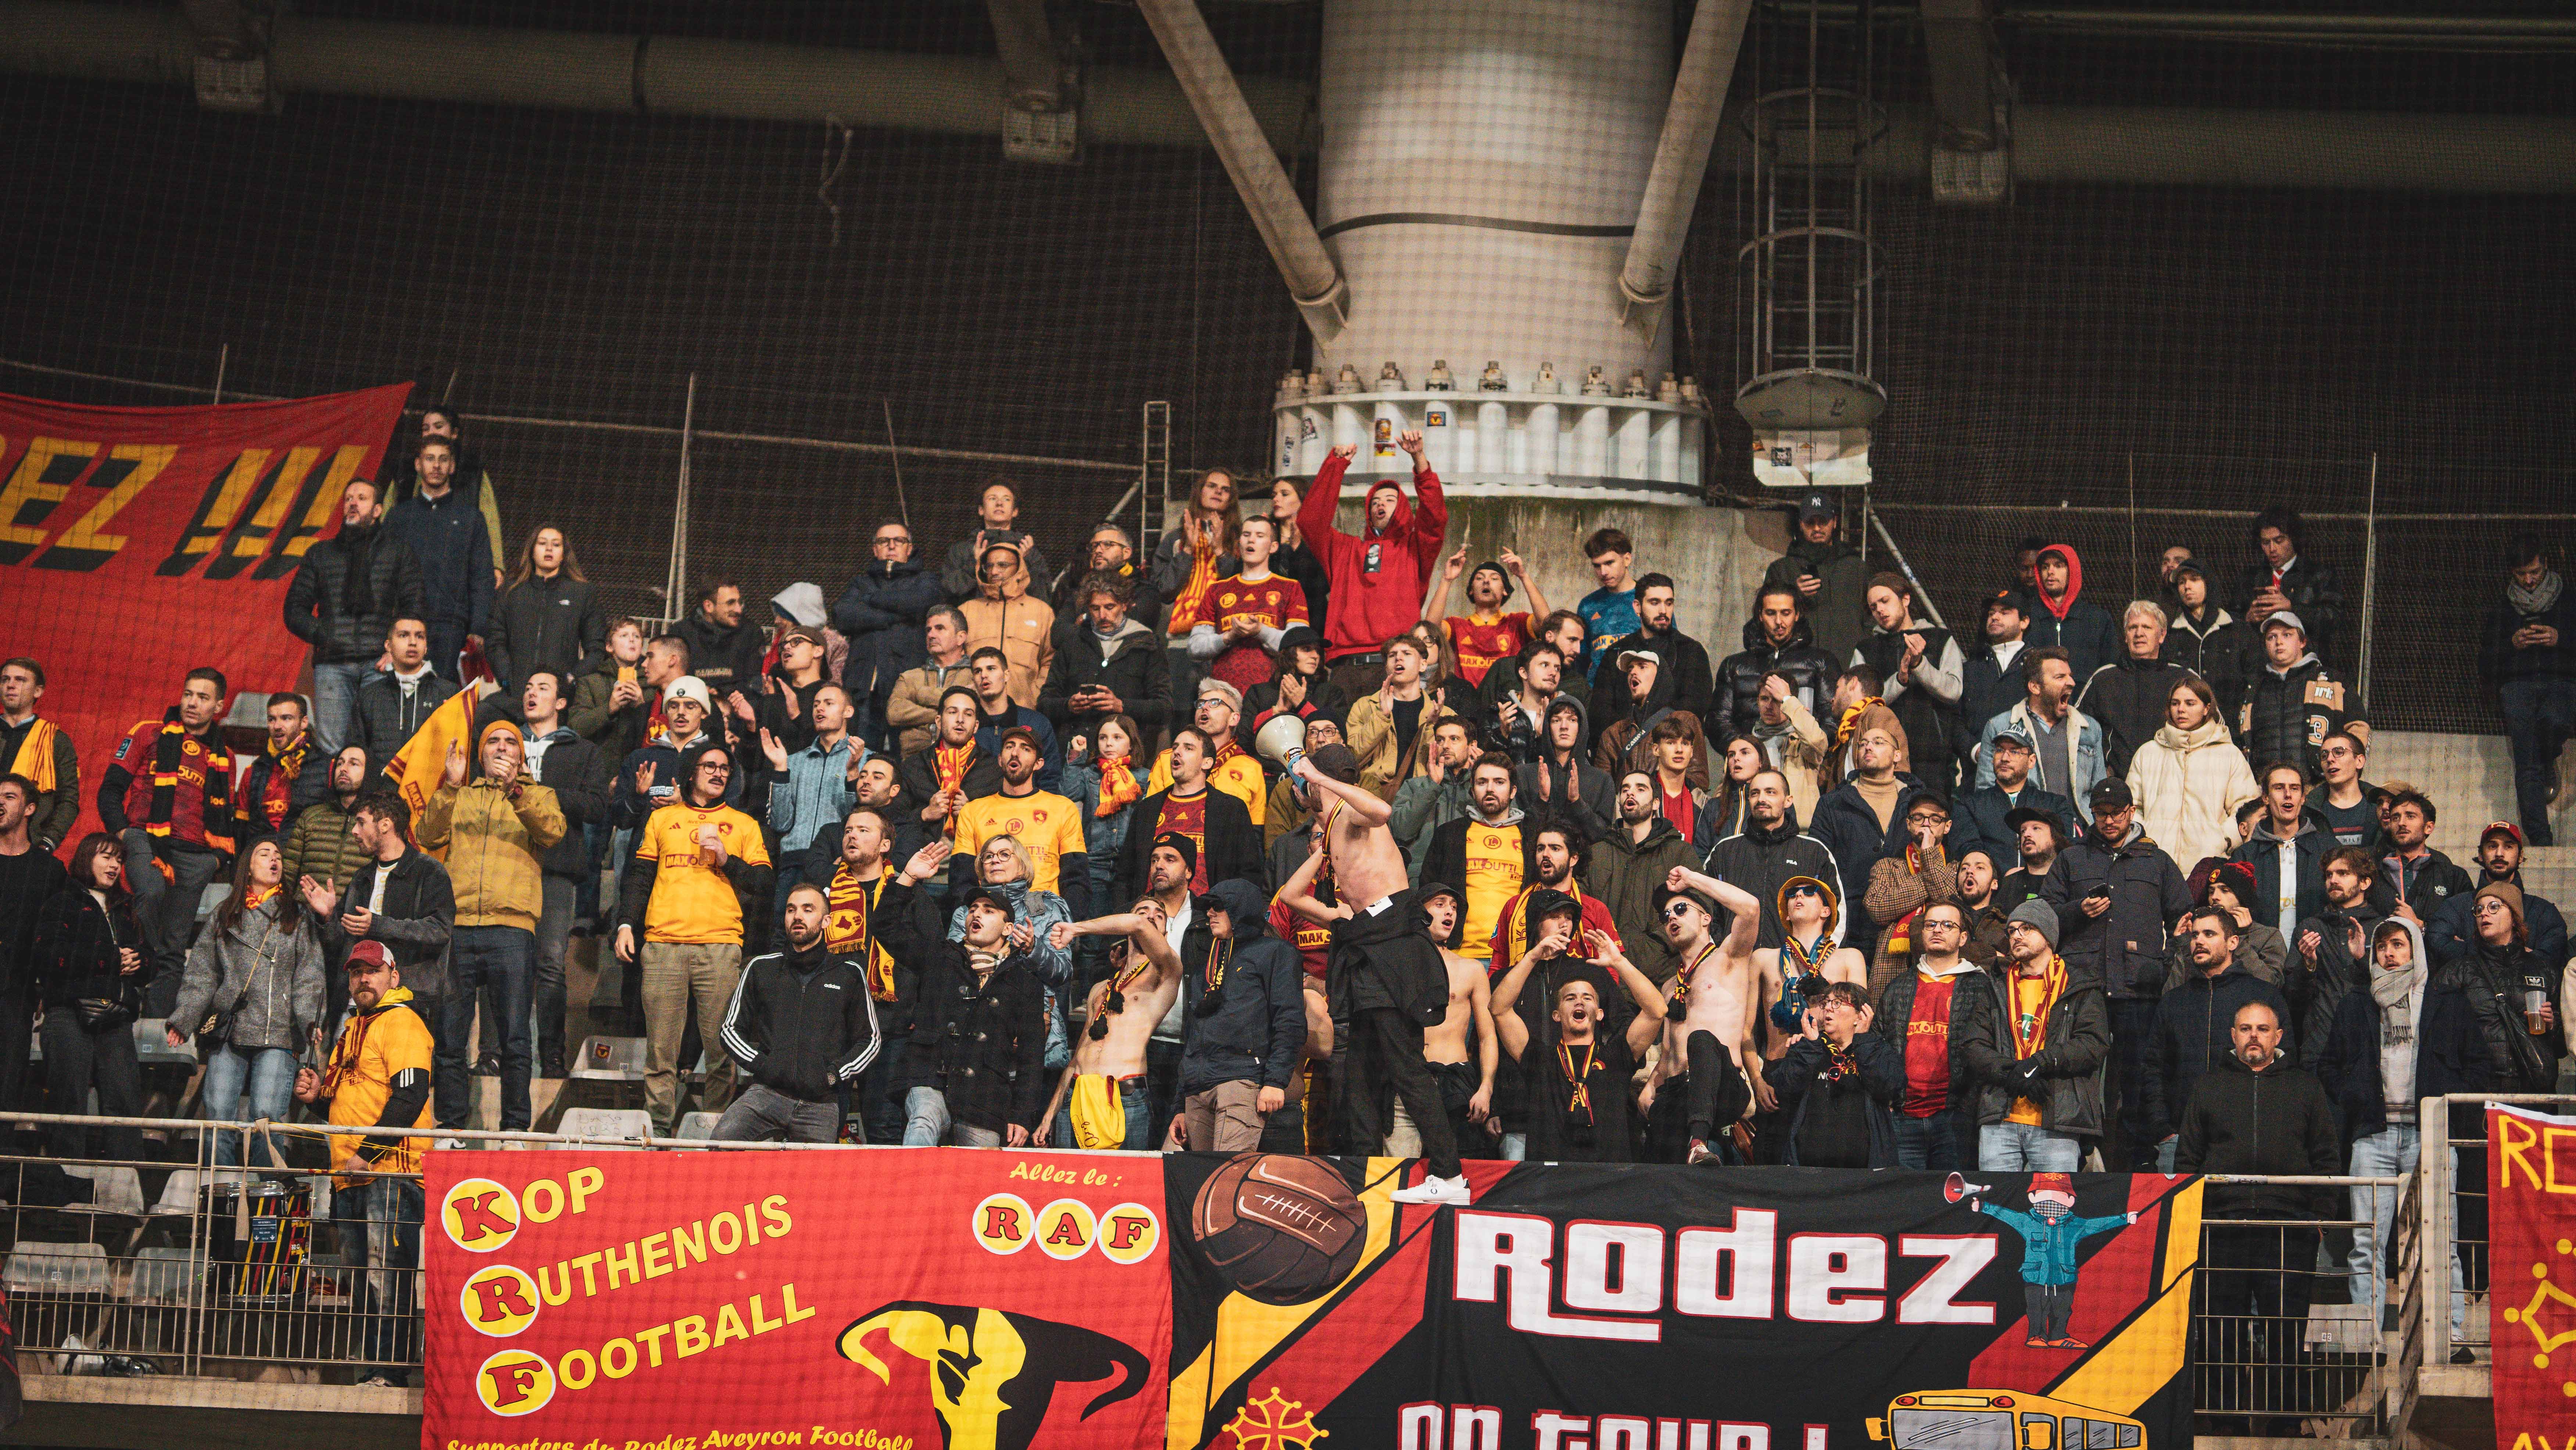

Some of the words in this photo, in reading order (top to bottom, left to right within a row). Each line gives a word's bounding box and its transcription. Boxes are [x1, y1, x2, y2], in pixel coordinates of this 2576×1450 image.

[0, 436, 179, 551] EZ
[1626, 729, 1646, 750] Canon
[666, 855, 688, 867] MAX
[1485, 862, 1519, 876] OUTIL
[1300, 933, 1323, 944] MAX
[1921, 1024, 1947, 1034] OUTI
[1009, 1161, 1077, 1185] Allez
[1083, 1168, 1108, 1186] le
[451, 1166, 605, 1242] KOP
[983, 1206, 1151, 1249] RAF
[471, 1194, 793, 1322] RUTHENOIS
[1452, 1207, 1999, 1343] Rodez
[485, 1282, 816, 1408] FOOTBALL
[702, 1430, 801, 1450] Aveyron
[809, 1426, 913, 1450] Football
